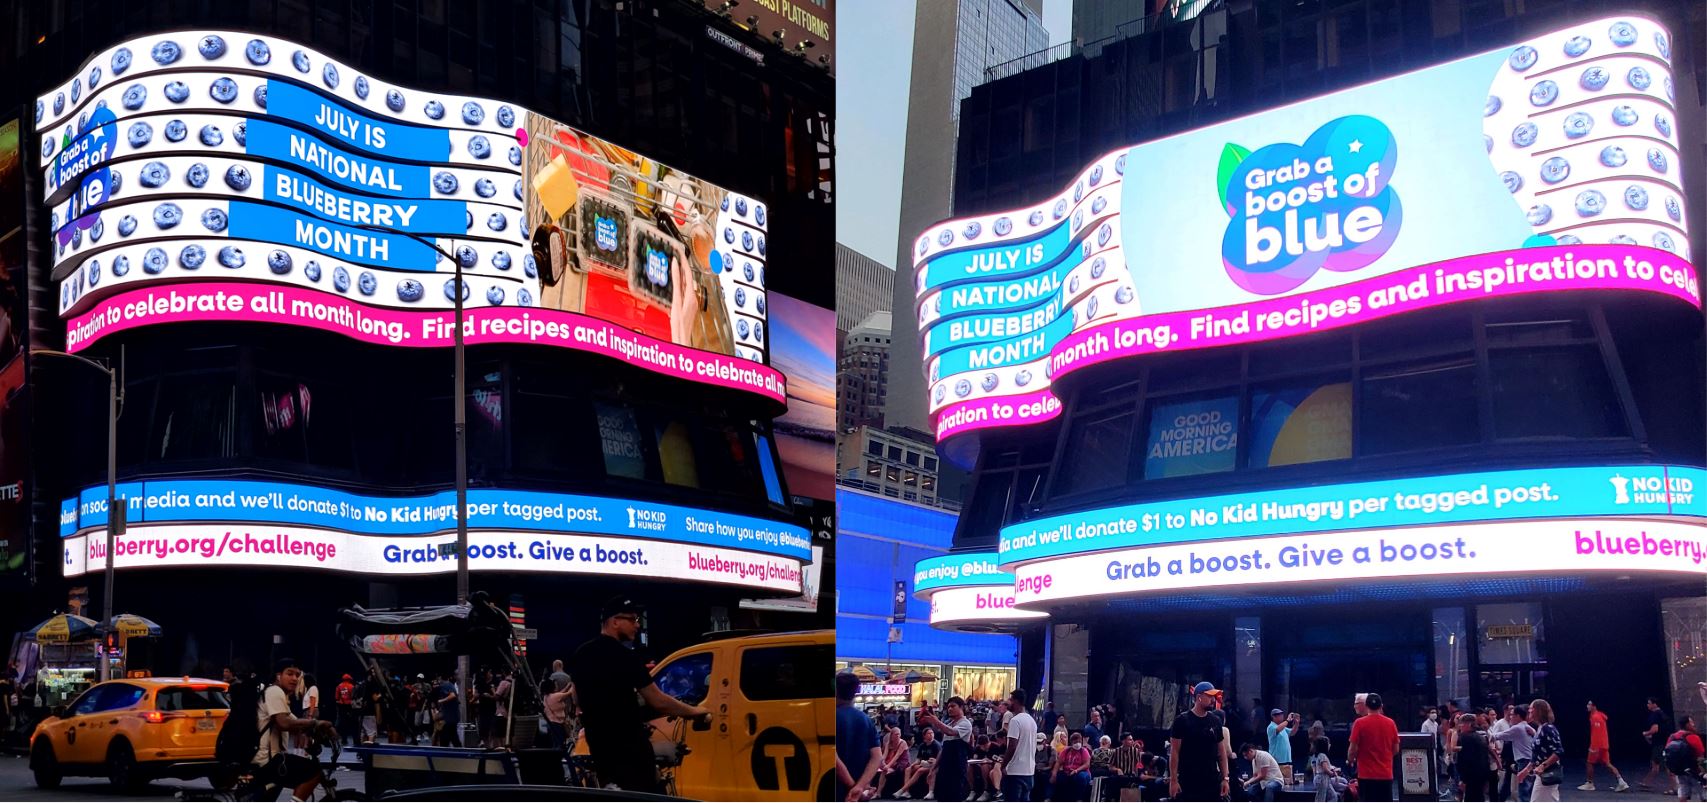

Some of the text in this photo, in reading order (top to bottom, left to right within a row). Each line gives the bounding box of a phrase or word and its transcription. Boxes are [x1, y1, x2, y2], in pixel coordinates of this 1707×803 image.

[781, 0, 830, 41] PLATFORMS
[707, 27, 742, 53] OUTFRONT
[314, 103, 386, 149] JULY IS
[60, 138, 89, 166] Grab a
[60, 143, 107, 185] boost of
[289, 134, 402, 191] NATIONAL
[1245, 156, 1334, 190] Grab a
[1245, 162, 1380, 217] boost of
[276, 173, 418, 227] BLUEBERRY
[295, 219, 389, 261] MONTH
[1245, 206, 1384, 265] blue
[965, 243, 1044, 274] JULY IS
[952, 271, 1061, 309] NATIONAL
[950, 292, 1061, 341] BLUEBERRY
[1053, 253, 1699, 373] month long. Find recipes and inspiration to cele
[66, 312, 105, 350] piration
[106, 305, 121, 325] to
[124, 290, 244, 320] celebrate
[250, 291, 286, 314] all
[291, 299, 354, 330] month
[356, 310, 411, 343] long.
[481, 312, 570, 341] recipes
[574, 326, 607, 348] and
[610, 330, 677, 369] inspiration
[679, 354, 694, 373] to
[696, 359, 764, 388] celebrate
[765, 373, 777, 392] all
[968, 332, 1045, 368] MONTH
[991, 403, 1014, 419] to
[1174, 410, 1221, 428] GOOD
[1149, 433, 1238, 459] AMERICA
[1161, 421, 1232, 441] MORNING
[1633, 476, 1693, 493] NO KID
[1633, 491, 1694, 505] HUNGRY
[130, 490, 190, 509] media
[195, 491, 235, 508] and
[287, 495, 338, 516] donate
[340, 502, 349, 518] $1
[350, 504, 361, 520] to
[364, 506, 387, 522] No
[391, 506, 421, 523] Kid
[424, 503, 458, 522] Hungry
[467, 501, 498, 521] per
[502, 501, 564, 521] tagged
[567, 506, 602, 523] post.
[637, 509, 666, 523] NO KID
[1012, 531, 1037, 550] and
[1075, 518, 1138, 540] donate
[1142, 512, 1160, 532] $1
[1165, 513, 1185, 529] to
[1190, 508, 1218, 527] No
[1222, 502, 1258, 524] Kid
[1262, 498, 1344, 522] Hungry
[1349, 494, 1388, 518] per
[1394, 484, 1489, 513] tagged
[1494, 482, 1559, 507] post.
[637, 520, 666, 531] HUNGRY
[685, 516, 714, 534] Share
[716, 521, 737, 537] how
[737, 526, 754, 542] you
[755, 528, 778, 547] enjoy
[89, 531, 336, 562] bluberry.org/challenge
[383, 544, 438, 563] Grab
[454, 541, 523, 560] oost.
[529, 540, 575, 561] Give
[579, 547, 592, 562] a
[596, 543, 648, 566] boost.
[1107, 537, 1476, 581] Grab a boost. Give a boost.
[928, 563, 959, 579] enjoy
[961, 559, 1006, 576] @blu
[859, 684, 906, 695] HALAL FOOD
[764, 744, 795, 791] T
